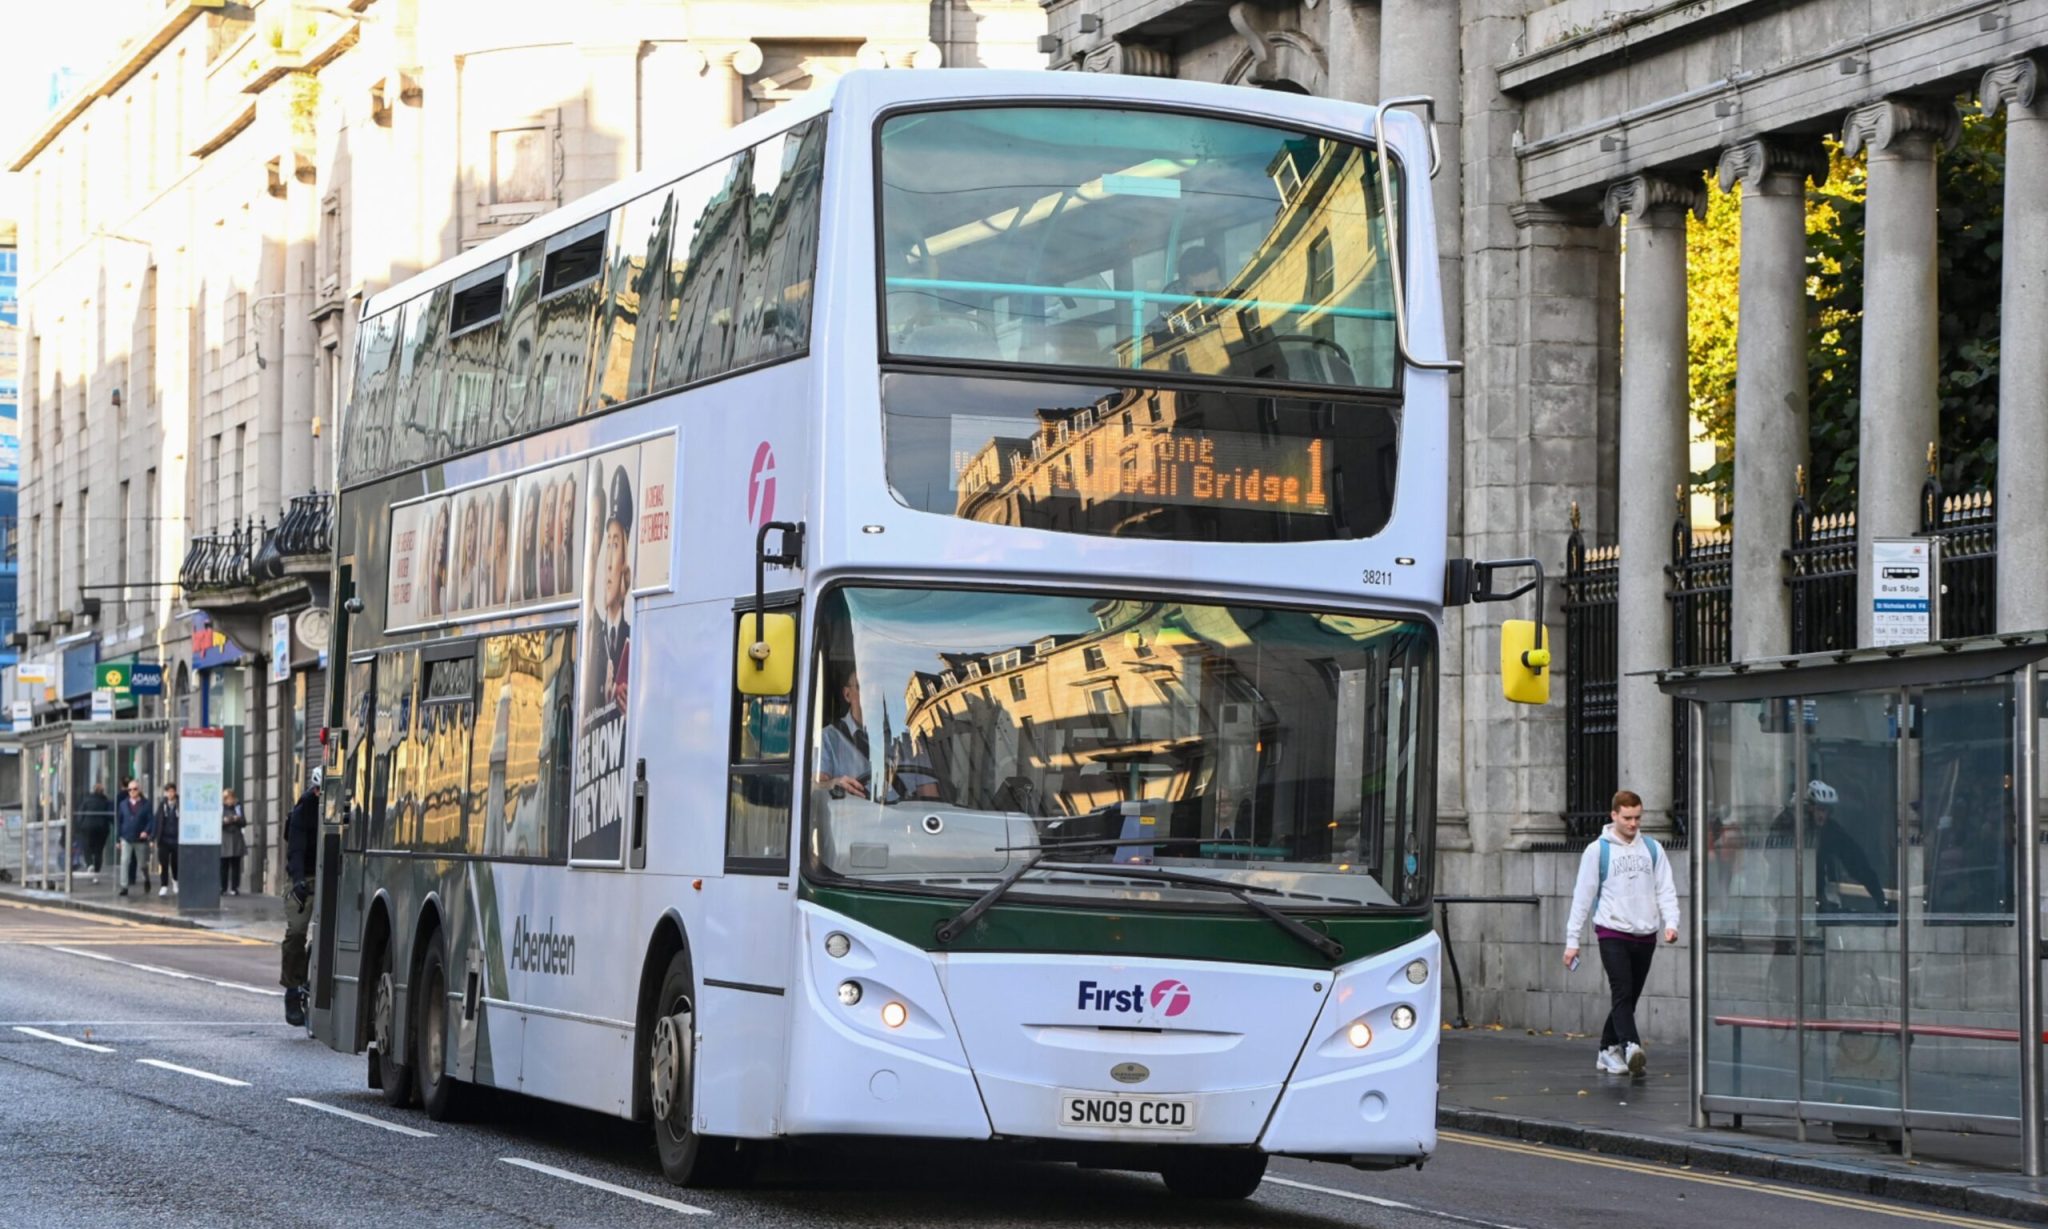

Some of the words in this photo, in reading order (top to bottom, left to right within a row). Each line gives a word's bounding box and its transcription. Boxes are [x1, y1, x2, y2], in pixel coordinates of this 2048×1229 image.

[1193, 465, 1300, 504] Bridge
[1306, 437, 1326, 506] 1
[664, 511, 670, 540] 9
[1362, 569, 1392, 586] 38211
[1882, 584, 1898, 592] Bus
[1900, 584, 1920, 593] Stop
[576, 735, 591, 791] SEE
[592, 715, 625, 780] HOW
[574, 780, 600, 843] THEY
[600, 768, 625, 828] RUN
[511, 914, 575, 976] Aberdeen
[1078, 981, 1144, 1013] First
[1071, 1099, 1132, 1124] SN09
[1140, 1102, 1186, 1125] CCD
